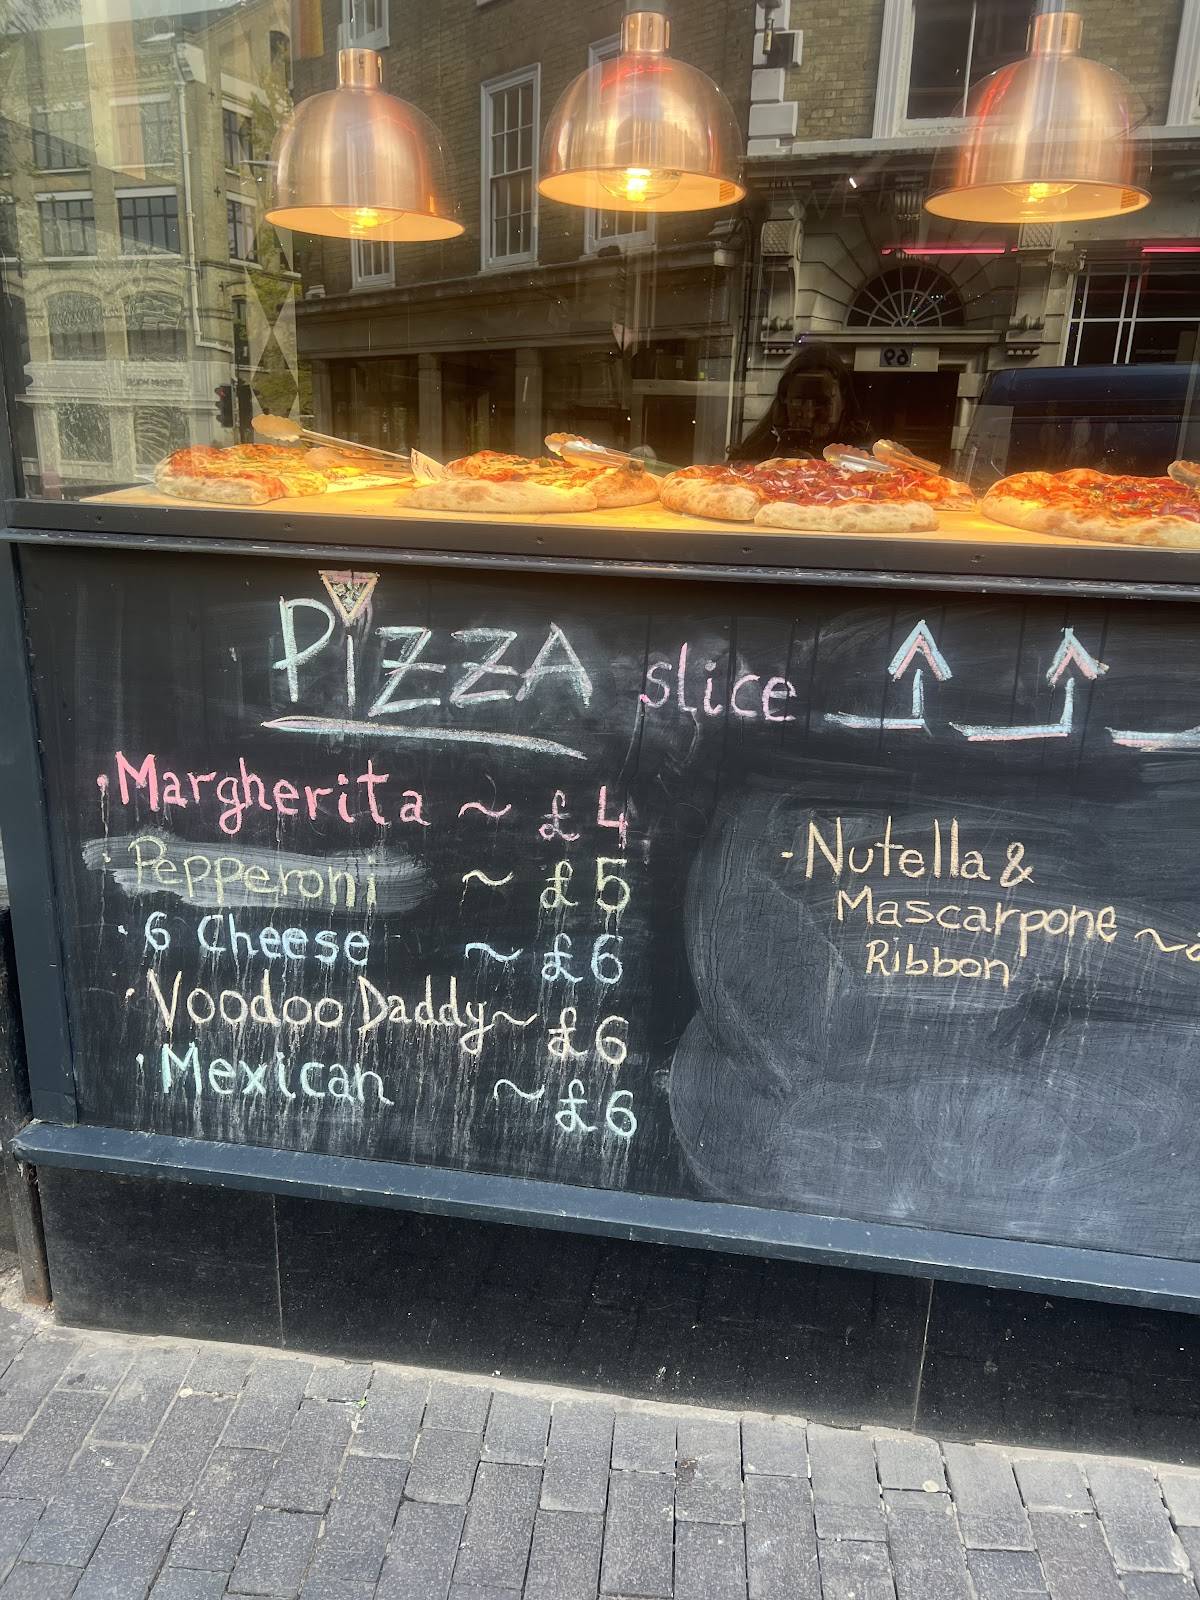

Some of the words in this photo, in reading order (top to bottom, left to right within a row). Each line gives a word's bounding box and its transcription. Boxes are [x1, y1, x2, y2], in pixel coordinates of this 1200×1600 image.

[638, 642, 797, 721] slice
[115, 751, 431, 837] Margherita
[128, 835, 379, 909] Pepperoni
[805, 815, 990, 882] Nutella
[1001, 841, 1035, 888] &
[144, 911, 171, 952] 6
[198, 913, 370, 965] Cheese
[836, 885, 1118, 957] Mascarpone
[865, 937, 1010, 987] Ribbon
[147, 968, 344, 1031] Voodoo
[358, 975, 492, 1056] Daddy
[161, 1042, 394, 1106] Mexican
